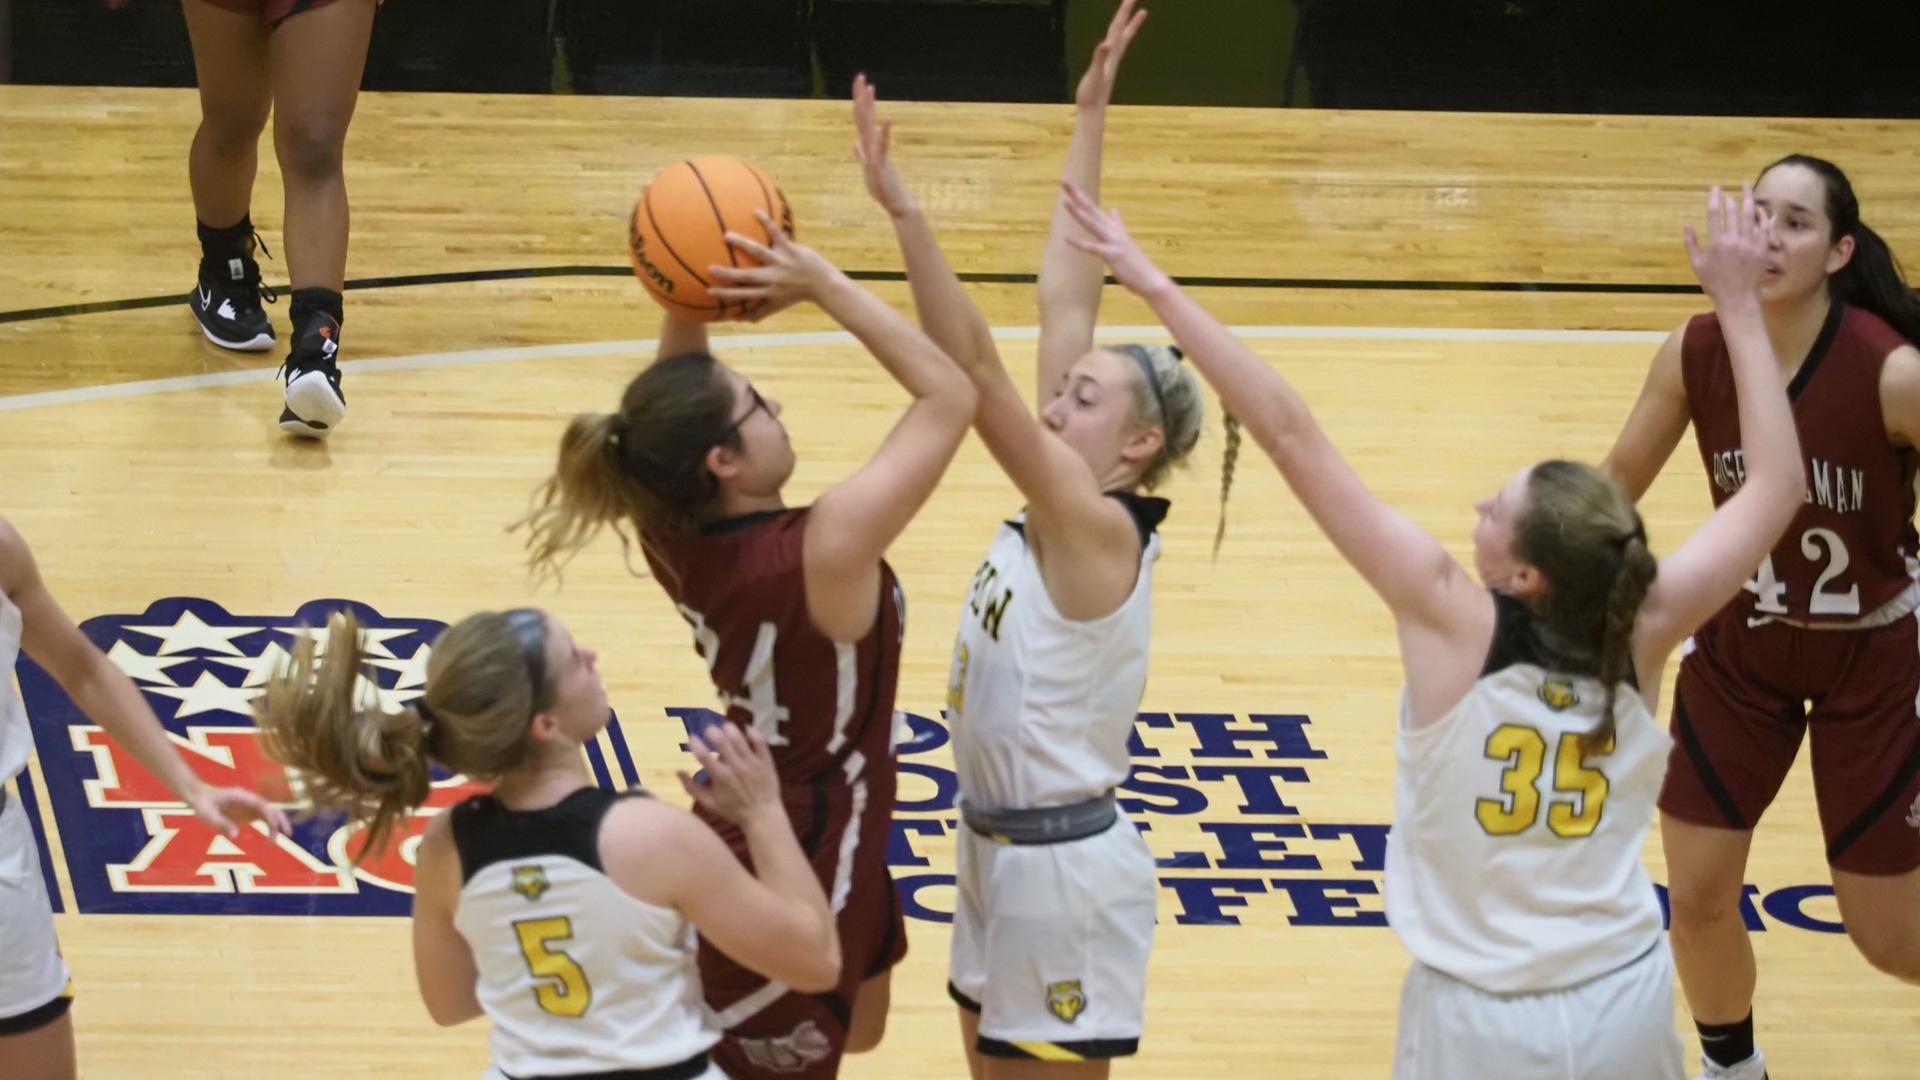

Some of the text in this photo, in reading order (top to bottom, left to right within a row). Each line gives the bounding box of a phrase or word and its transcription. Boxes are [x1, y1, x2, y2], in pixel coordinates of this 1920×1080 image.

[1743, 527, 1860, 615] 42
[1475, 723, 1616, 839] 35
[511, 916, 593, 1018] 5
